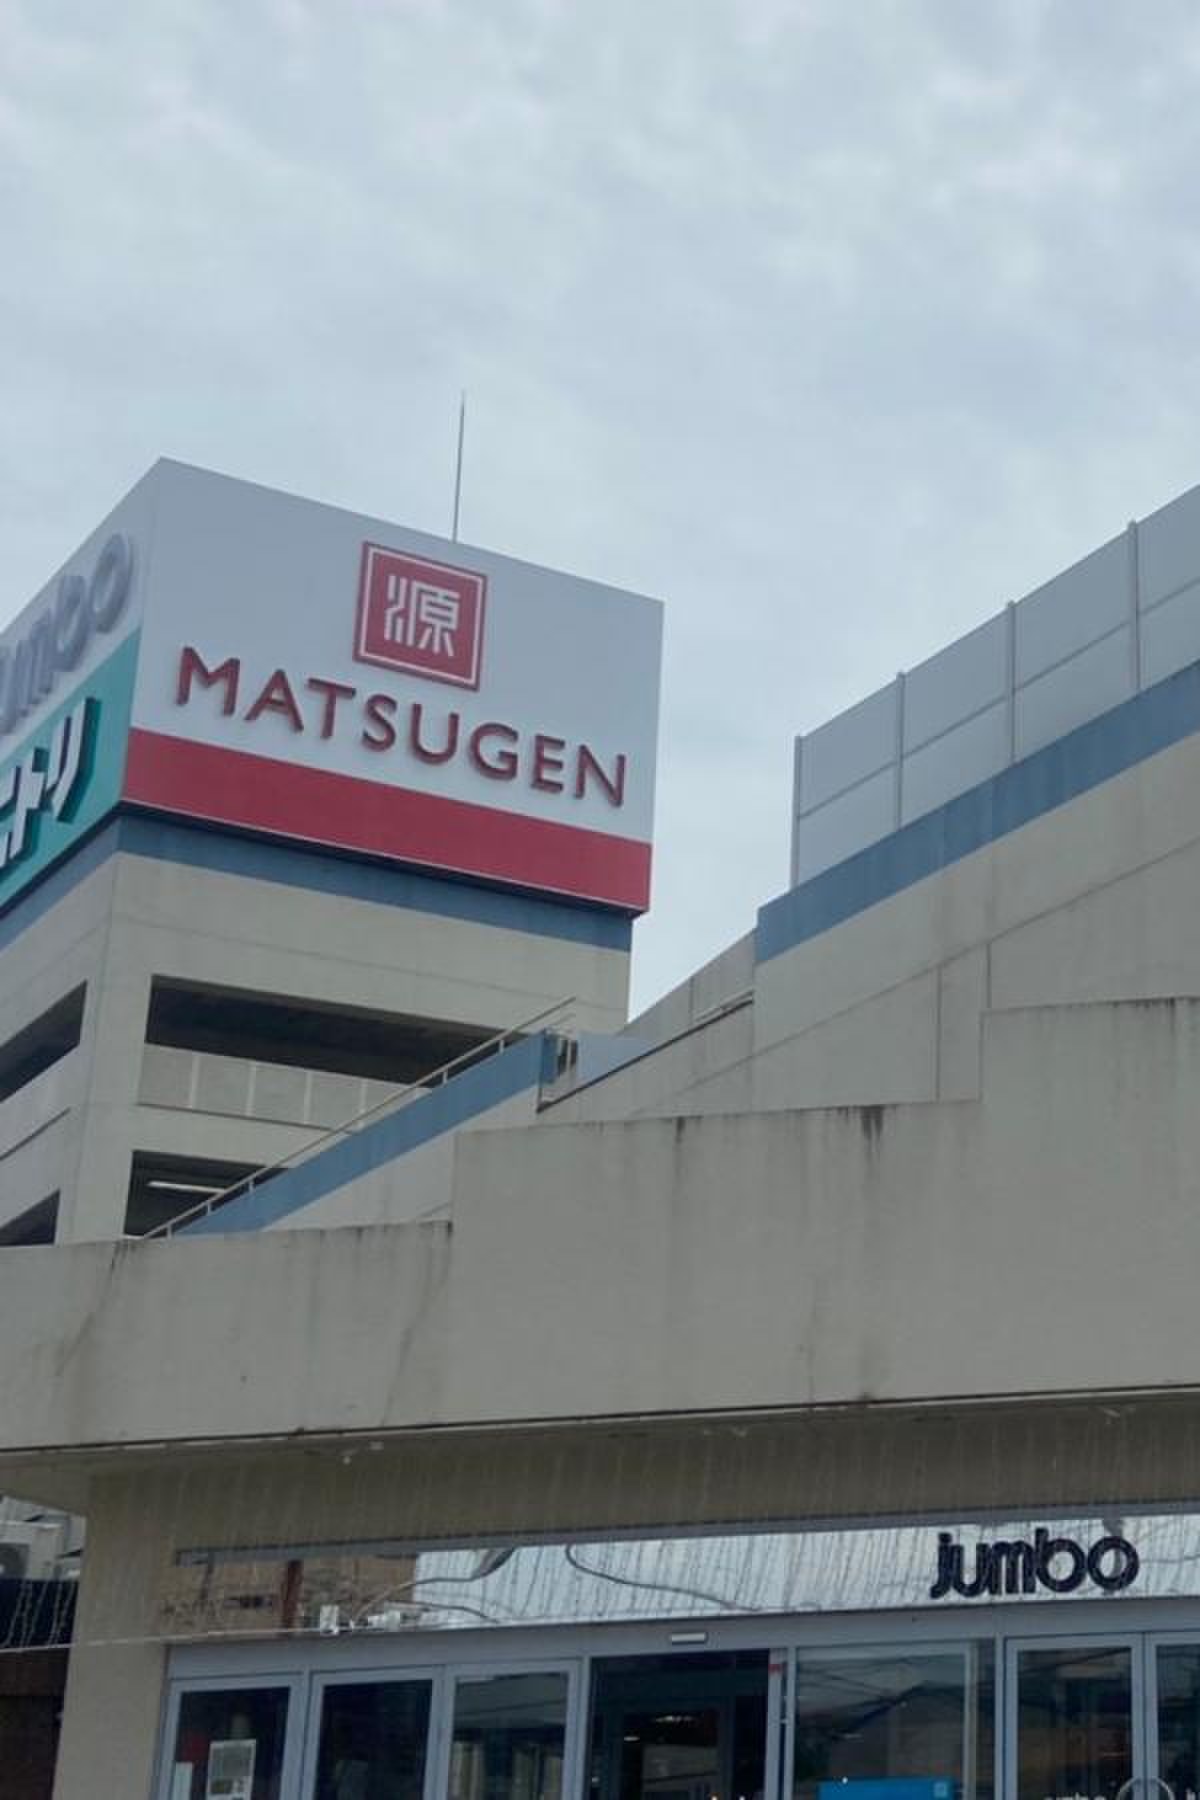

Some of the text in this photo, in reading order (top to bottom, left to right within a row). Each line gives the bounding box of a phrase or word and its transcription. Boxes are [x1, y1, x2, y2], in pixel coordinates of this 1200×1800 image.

[383, 574, 461, 658] 源
[175, 645, 626, 807] MATSUGEN
[929, 1527, 1140, 1599] jumbo
